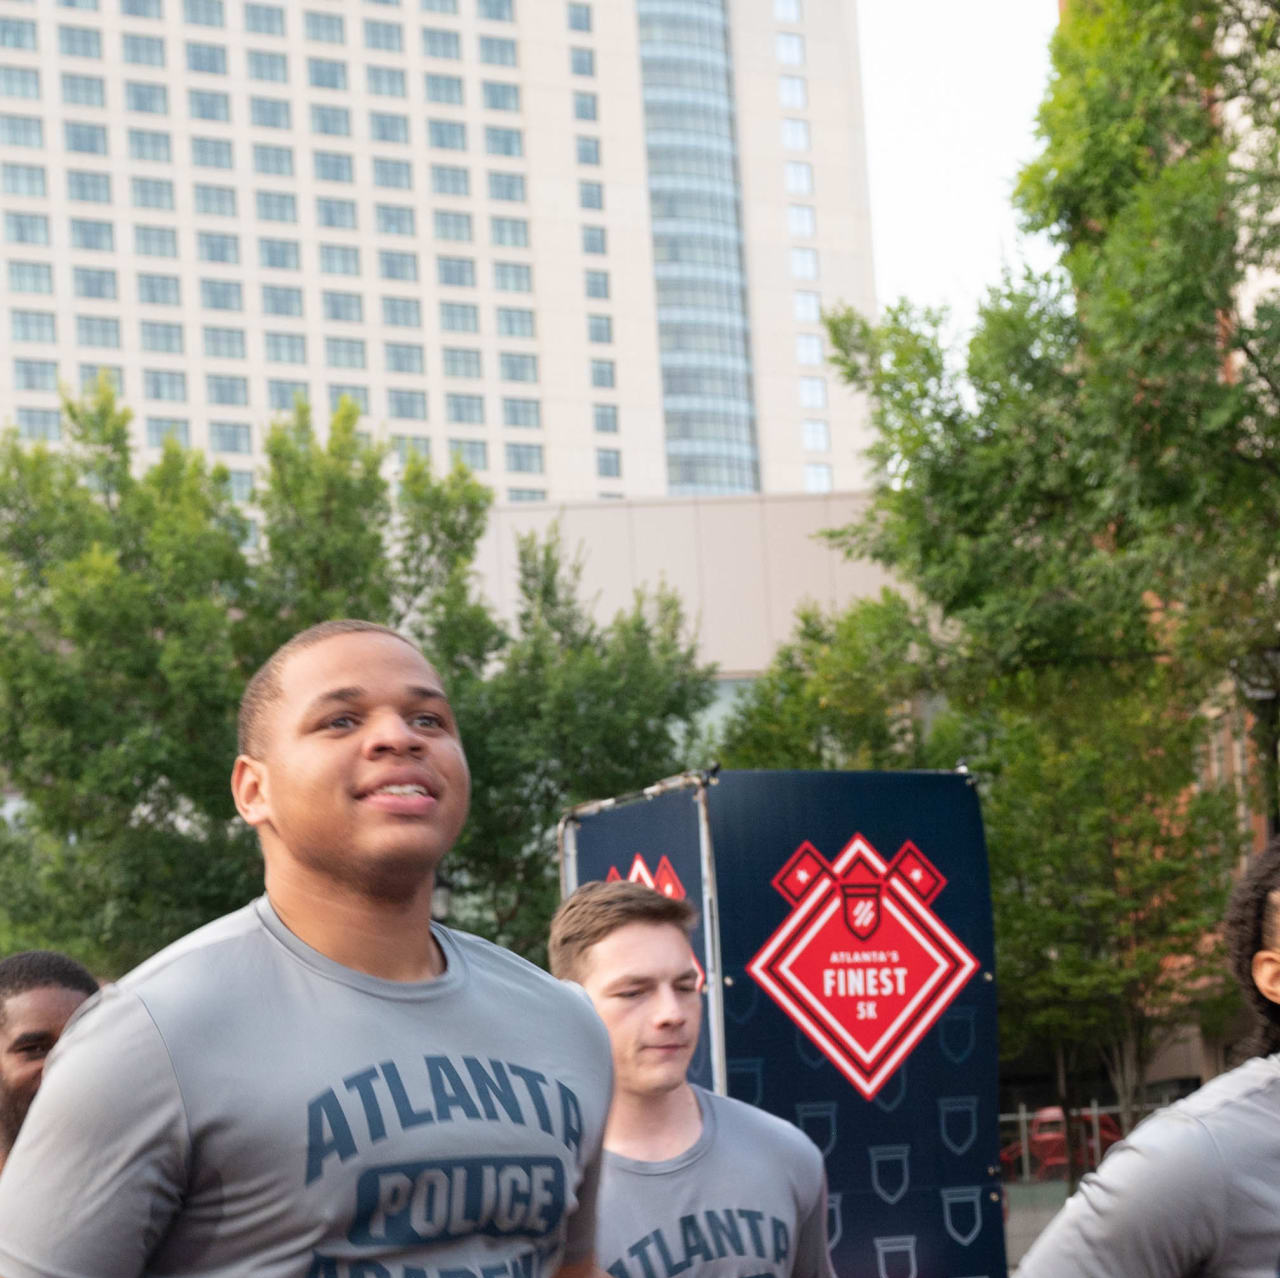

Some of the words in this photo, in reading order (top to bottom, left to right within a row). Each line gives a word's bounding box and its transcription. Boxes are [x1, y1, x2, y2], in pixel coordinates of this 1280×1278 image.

[830, 950, 900, 963] ATLANTA'S
[823, 967, 908, 998] FINEST
[856, 1001, 878, 1020] 5K
[304, 1055, 583, 1187] ATLANTA
[368, 1163, 556, 1238] POLICE
